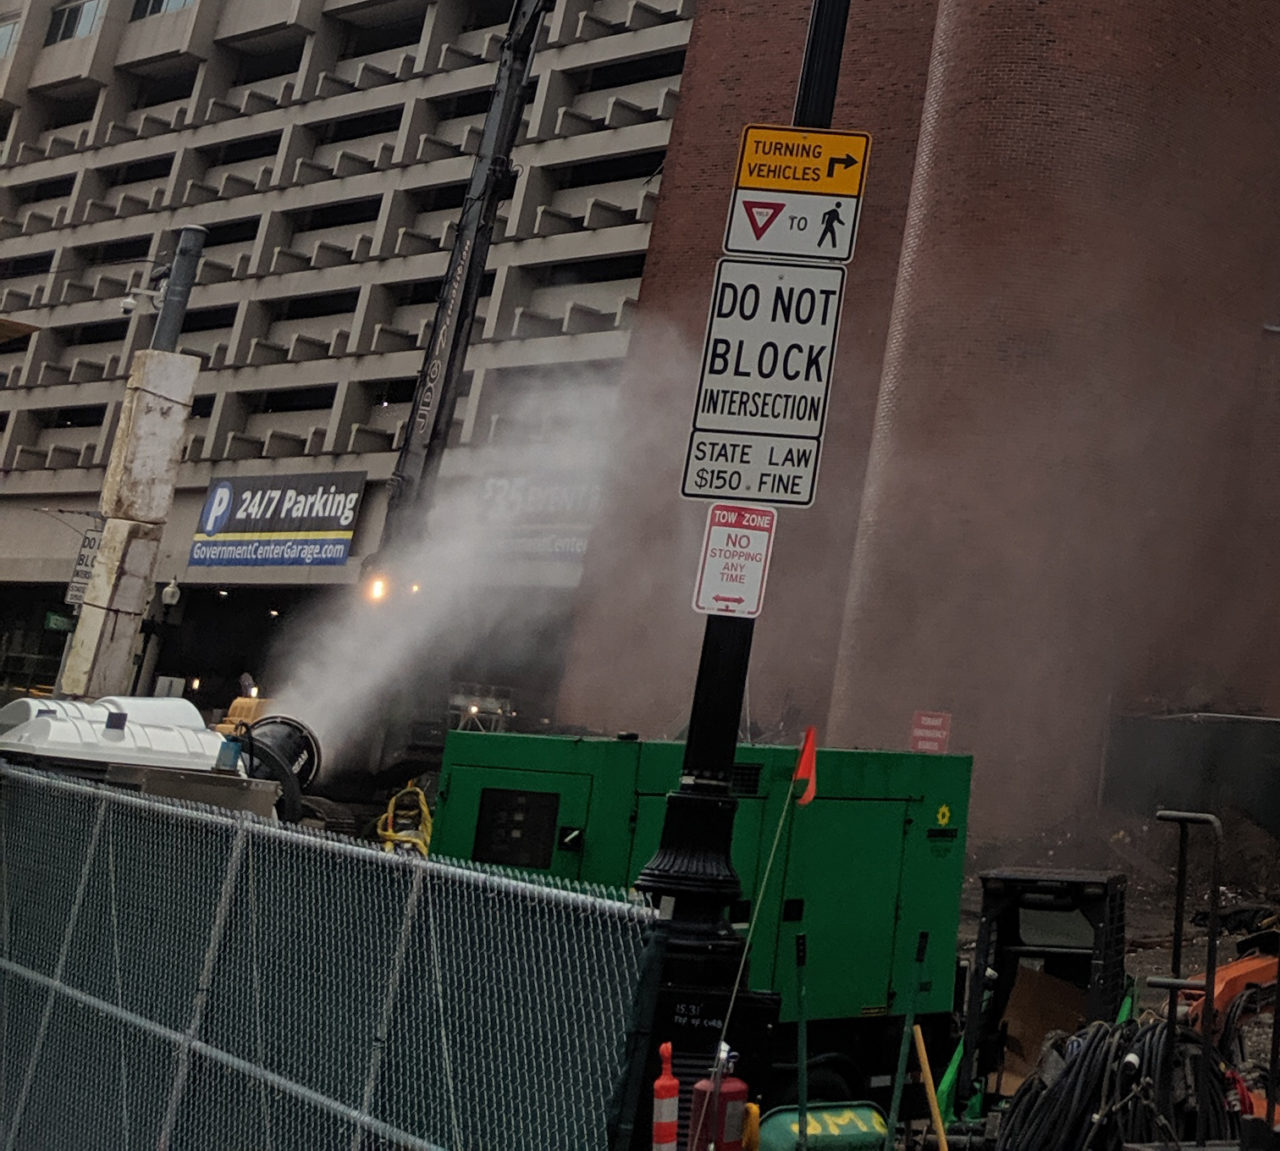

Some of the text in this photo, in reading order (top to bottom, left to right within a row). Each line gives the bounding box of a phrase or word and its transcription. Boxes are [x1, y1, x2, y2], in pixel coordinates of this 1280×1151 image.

[753, 140, 823, 159] TURNING
[747, 163, 822, 182] VEHICLES
[788, 215, 808, 232] TO
[716, 282, 837, 326] DO NOT
[708, 338, 827, 382] BLOCK
[416, 360, 441, 433] JDC
[701, 388, 821, 421] INTERSECTION
[694, 441, 812, 468] STATE LAW
[757, 473, 803, 495] FINE
[206, 487, 230, 531] P
[235, 485, 359, 526] 24/7 Parking
[714, 510, 771, 528] TOW ZONE
[82, 536, 96, 549] DO
[725, 533, 750, 549] NO
[193, 542, 344, 563] GovernmentCenterGarage.com
[709, 549, 762, 563] STOPPING
[722, 562, 746, 573] ANY
[719, 572, 746, 584] TIME
